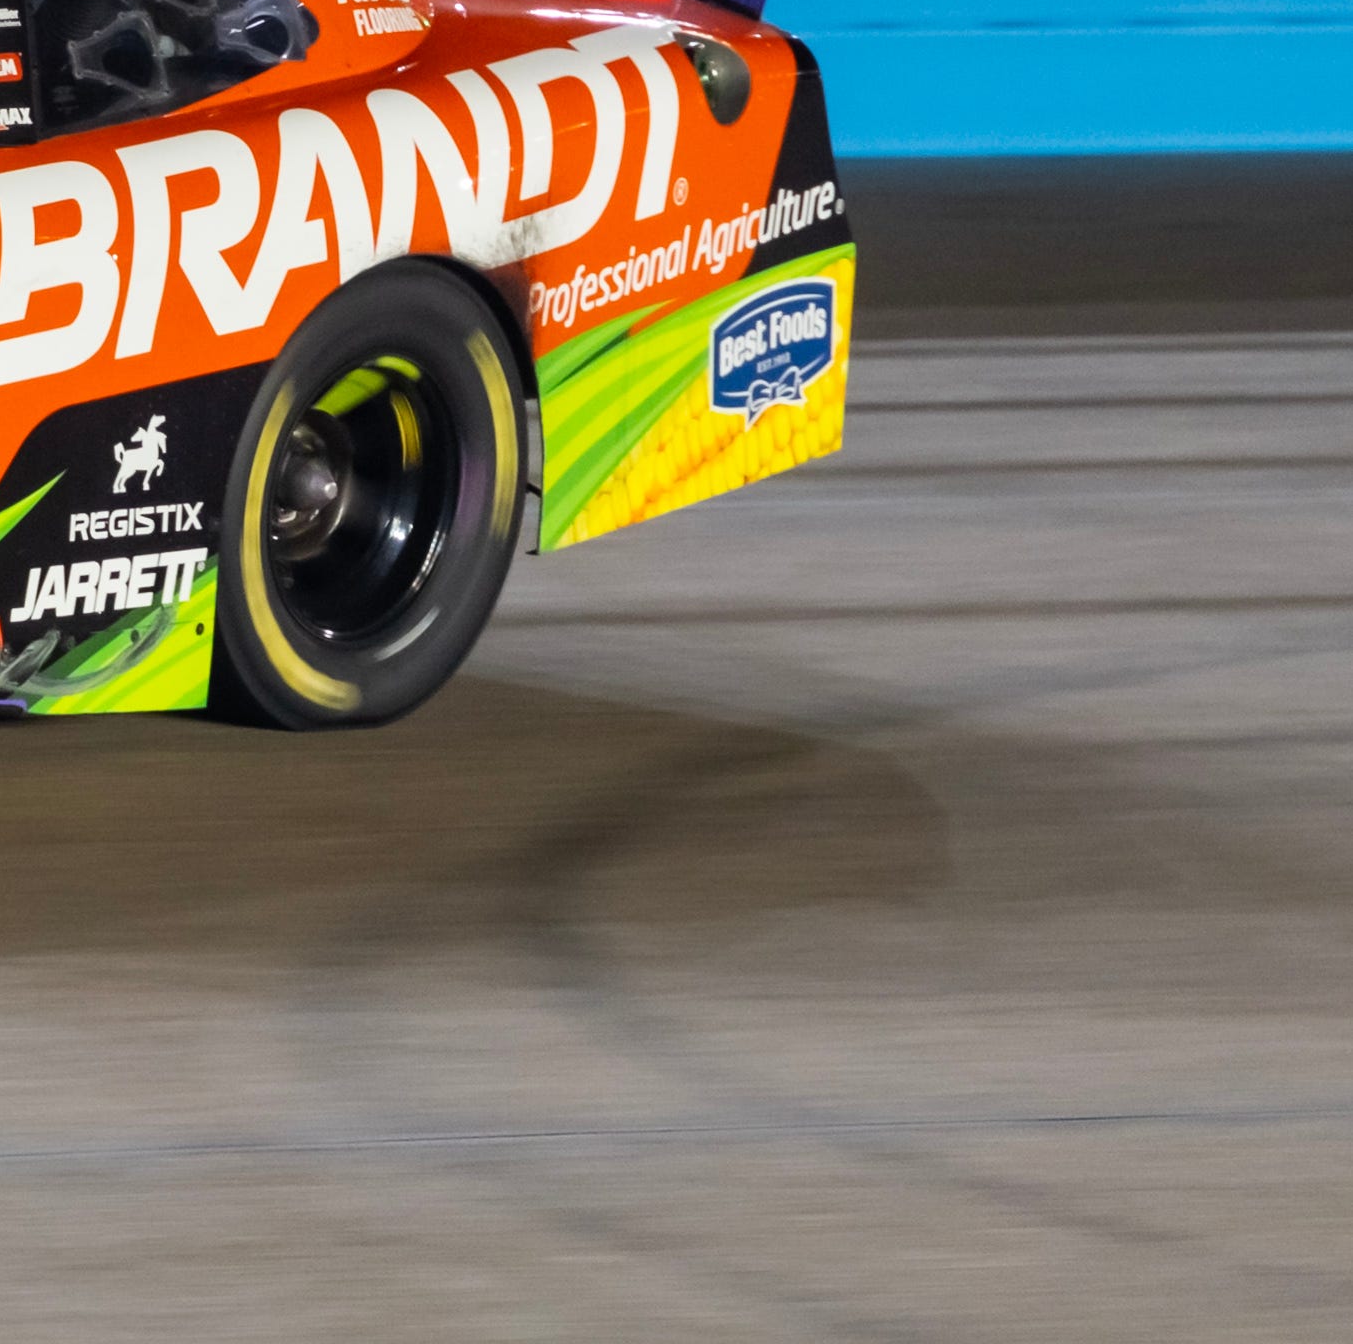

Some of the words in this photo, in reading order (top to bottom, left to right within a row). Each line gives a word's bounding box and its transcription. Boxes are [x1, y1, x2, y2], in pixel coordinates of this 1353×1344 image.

[353, 6, 423, 36] FLOORING
[529, 224, 692, 328] Professional
[719, 319, 768, 377] Best
[769, 302, 827, 349] Foods
[69, 502, 204, 542] REGISTIX
[10, 547, 208, 623] JARRETT
